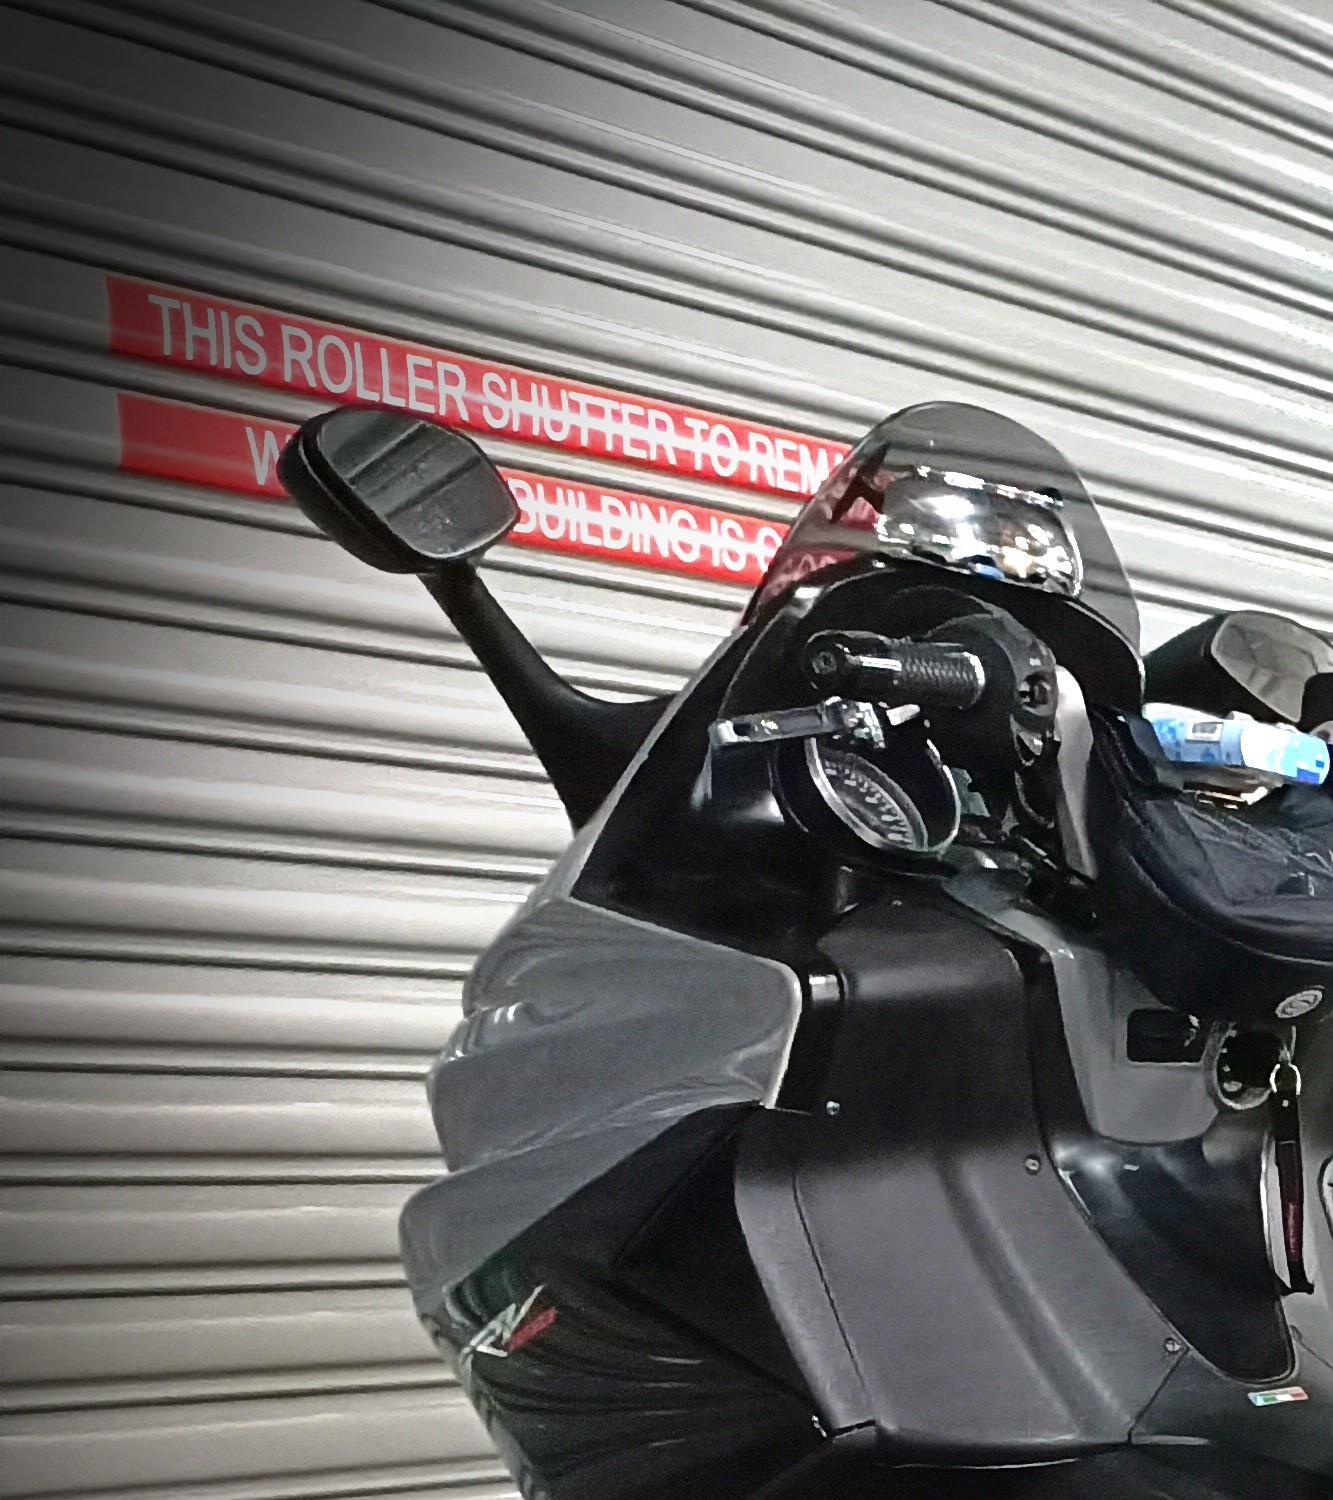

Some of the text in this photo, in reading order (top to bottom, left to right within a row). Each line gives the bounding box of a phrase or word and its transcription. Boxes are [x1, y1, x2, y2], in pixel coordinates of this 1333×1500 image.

[148, 295, 844, 495] THIS ROLLER SHUTTER TO REM
[507, 478, 700, 562] BUILDING
[711, 516, 746, 572] IS
